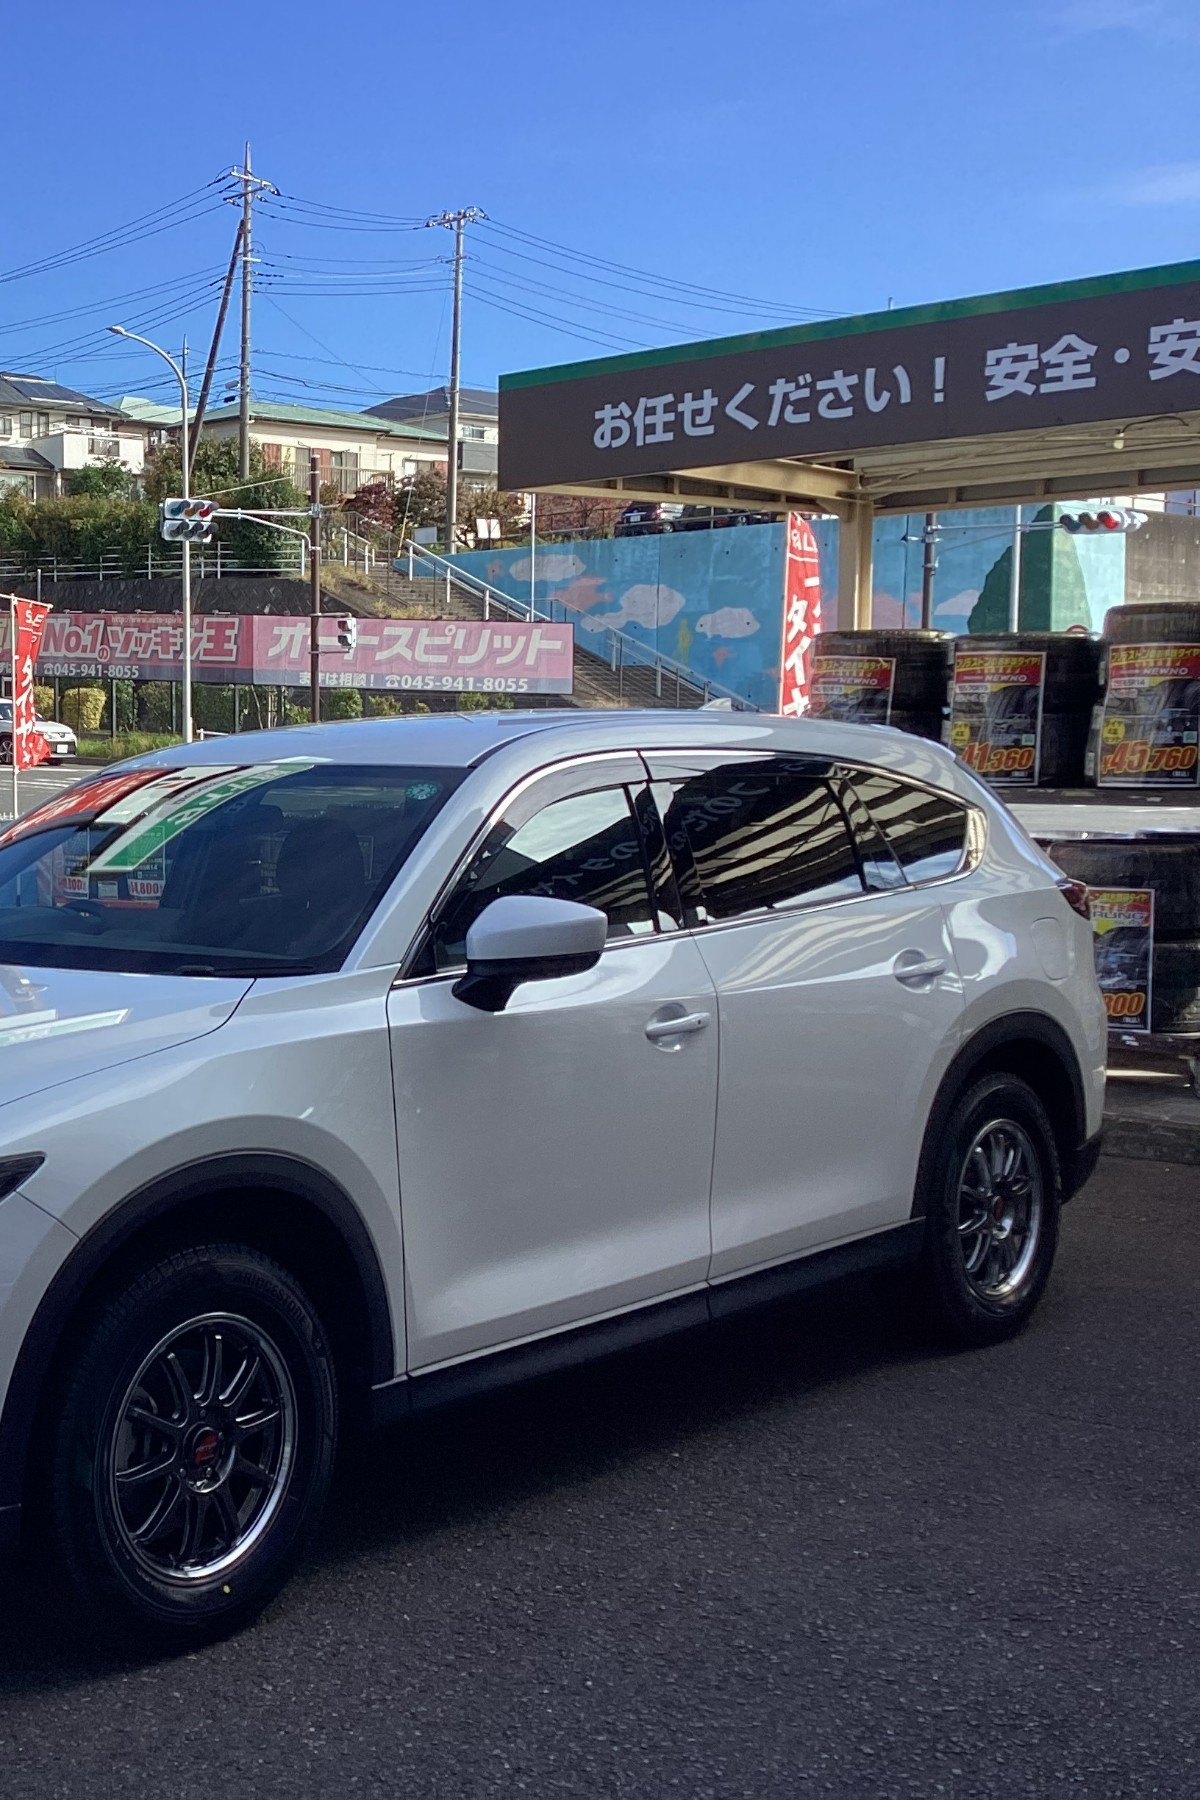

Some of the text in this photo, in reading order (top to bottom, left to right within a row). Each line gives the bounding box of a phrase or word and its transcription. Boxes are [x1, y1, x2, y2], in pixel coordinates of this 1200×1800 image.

[593, 355, 947, 449] お任せください！
[54, 664, 139, 678] 045-941-8055
[985, 674, 1027, 682] NEWNO
[401, 676, 528, 692] 045-941-8055
[838, 676, 878, 686] NEWNO
